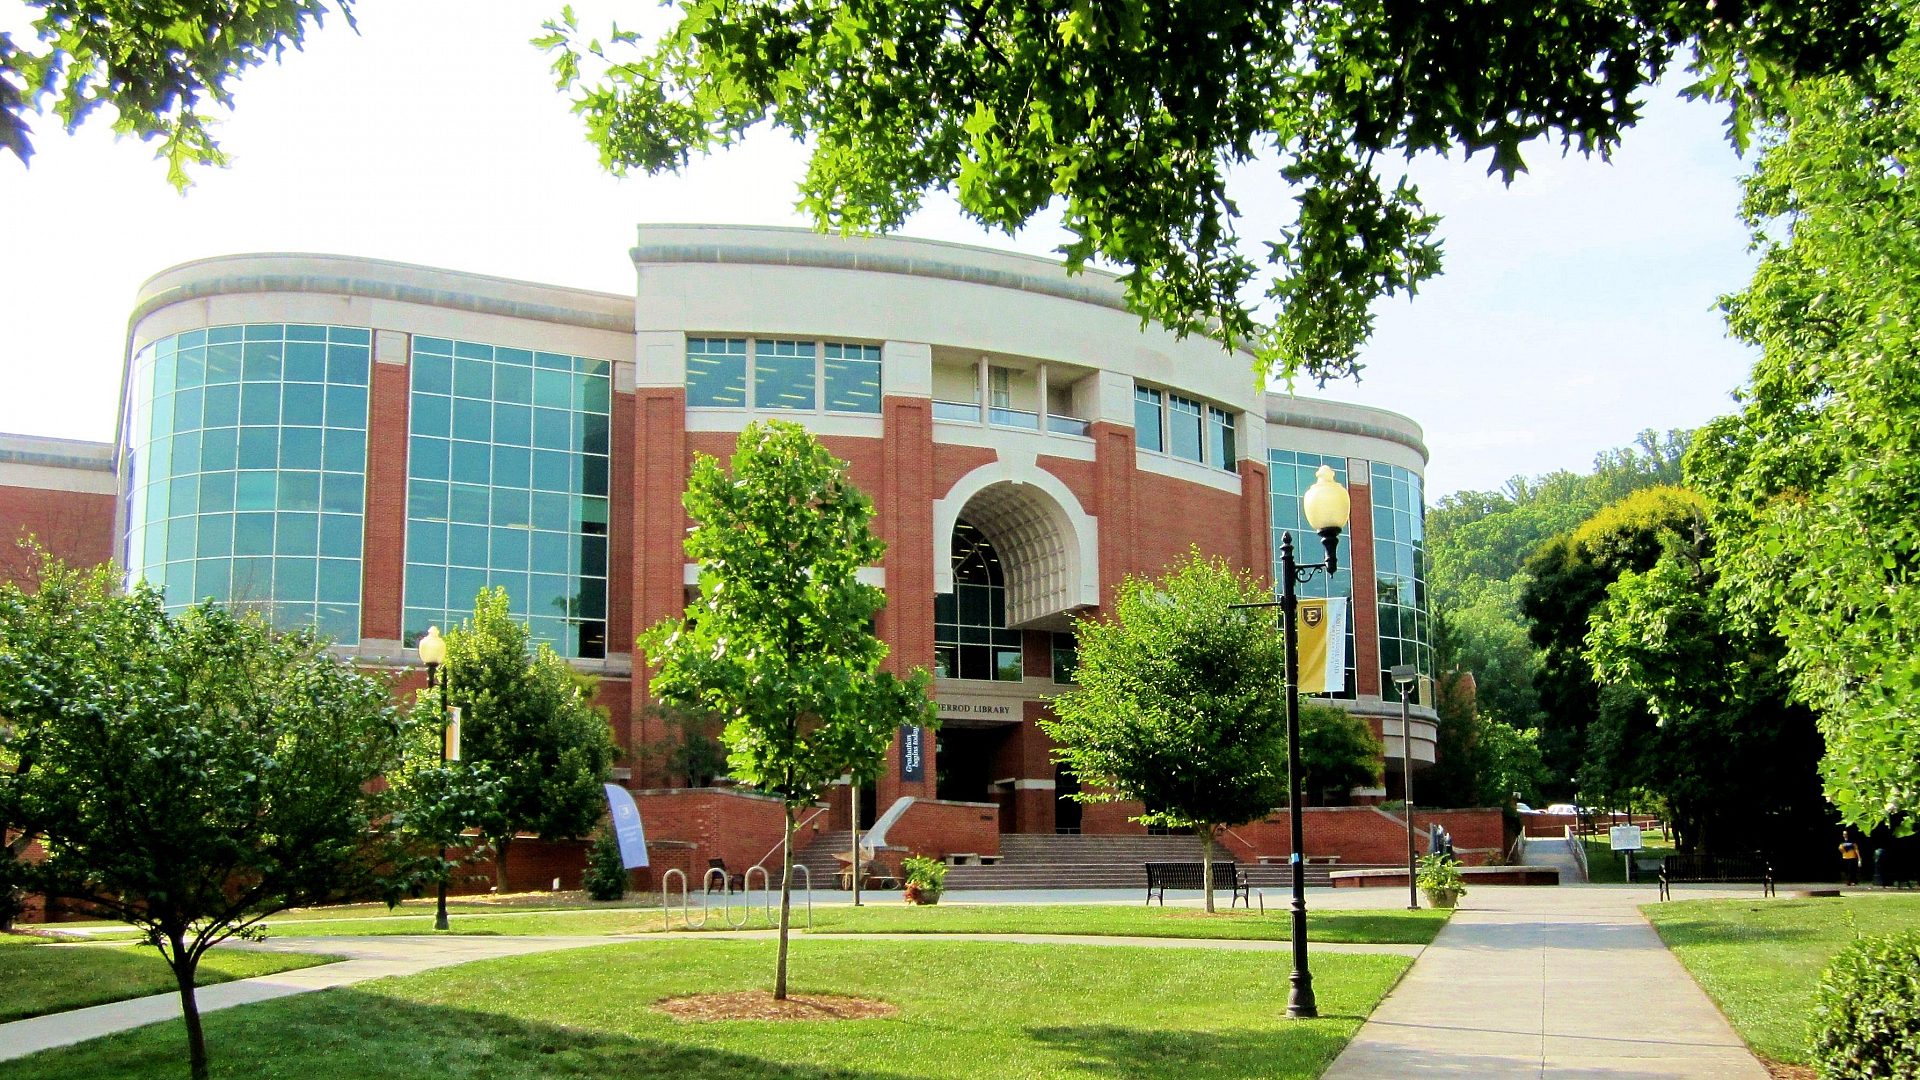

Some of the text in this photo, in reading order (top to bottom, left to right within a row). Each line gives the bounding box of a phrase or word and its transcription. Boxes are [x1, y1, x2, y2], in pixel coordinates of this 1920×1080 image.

[1307, 610, 1318, 622] E
[938, 704, 1010, 714] ERROD LIBRARY
[912, 746, 920, 768] begins
